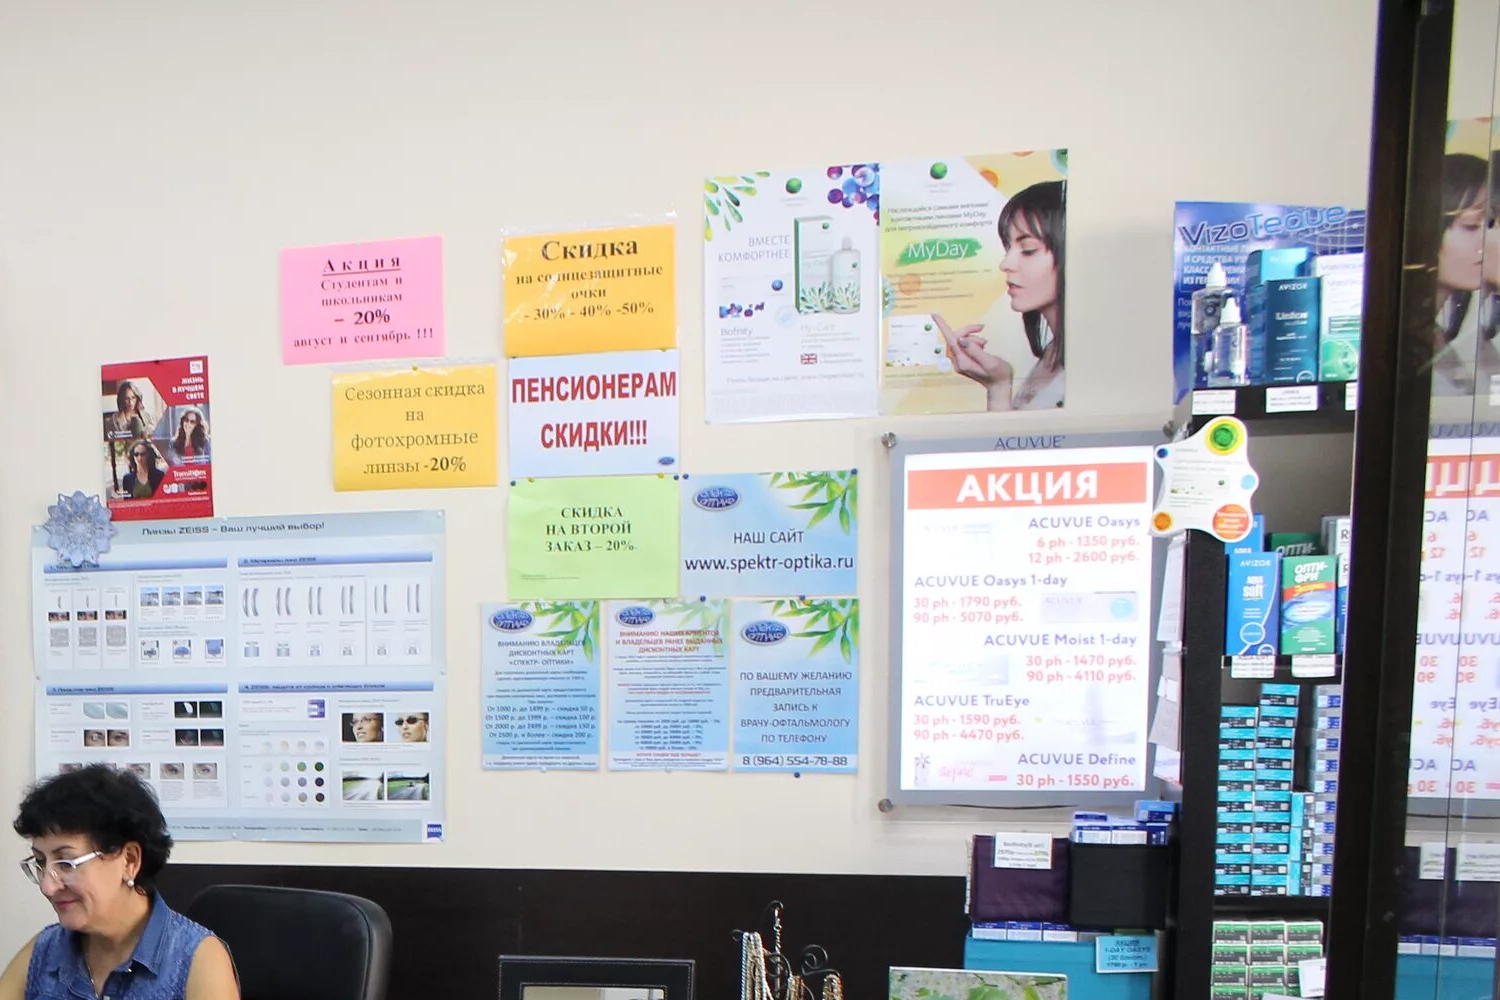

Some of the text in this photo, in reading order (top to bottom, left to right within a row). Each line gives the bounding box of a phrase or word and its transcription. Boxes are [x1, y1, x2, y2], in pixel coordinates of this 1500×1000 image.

[748, 235, 790, 246] ВМЕСТЕ
[541, 238, 639, 261] Скидка
[718, 249, 789, 262] КОМФОРТНЕЕ
[908, 240, 969, 260] MyDay
[322, 256, 402, 273] Акция
[321, 276, 403, 292] Студентам и
[516, 274, 533, 285] на
[321, 291, 403, 306] школьникам
[570, 288, 607, 301] очки
[579, 304, 611, 318] 40%
[616, 302, 654, 316] -50%
[354, 310, 391, 326] 20%
[293, 334, 333, 348] август
[354, 332, 411, 345] сентябрь
[345, 383, 486, 401] Сезонная скидка
[511, 371, 677, 403] ПЕНСИОНЕРАМ
[405, 409, 424, 422] на
[351, 430, 479, 450] фотохромные
[540, 420, 648, 452] СКИДКИ!!!
[363, 457, 467, 475] линзы -20%
[956, 470, 1098, 504] АКЦИЯ
[561, 506, 623, 519] СКИДКА
[178, 525, 209, 535] ZEISS
[220, 525, 244, 535] Ваш
[287, 522, 325, 534] выбор!
[546, 520, 632, 536] НА ВТОРОЙ
[1028, 516, 1140, 529] ACUVUE Oasys
[733, 530, 804, 545] НАШ САЙТ
[1037, 535, 1140, 550] 6 ph 1350 руб.
[546, 540, 592, 552] ЗАКАЗ
[684, 554, 854, 572] www.spektr-optika.ru
[1029, 550, 1140, 565] 12 ph 2600 руб.
[914, 574, 1068, 588] ACUVUE Oasys 1-day
[914, 595, 1022, 610] 30 ph 1790 руб.
[914, 610, 1023, 624] 90 ph 5070 руб.
[984, 634, 1137, 646] ACUVUE Moist 1-day
[1026, 654, 1137, 668] 30 ph 1470 руб.
[740, 672, 852, 680] ПО ВАШЕМУ ЖЕЛАНИЮ
[1026, 670, 1136, 683] 90 ph 4110 руб.
[750, 687, 841, 696] ПРЕДВАРИТЕЛЬНАЯ
[772, 704, 809, 712] ЗАПИСЬ
[914, 695, 1030, 708] ACUVUE TruEye
[741, 719, 850, 728] ВРАЧУ-ОФТАЛЬМОЛОГУ
[914, 713, 1021, 728] 30 ph 1590 руб.
[761, 734, 827, 743] ПО ТЕЛЕФОНУ
[914, 728, 1024, 742] 90 ph 4470 руб.
[743, 756, 848, 766] 8 (964) 554-78-88
[1018, 752, 1136, 765] ACUVUE Define
[1016, 774, 1134, 788] 30 ph 1550 руб.
